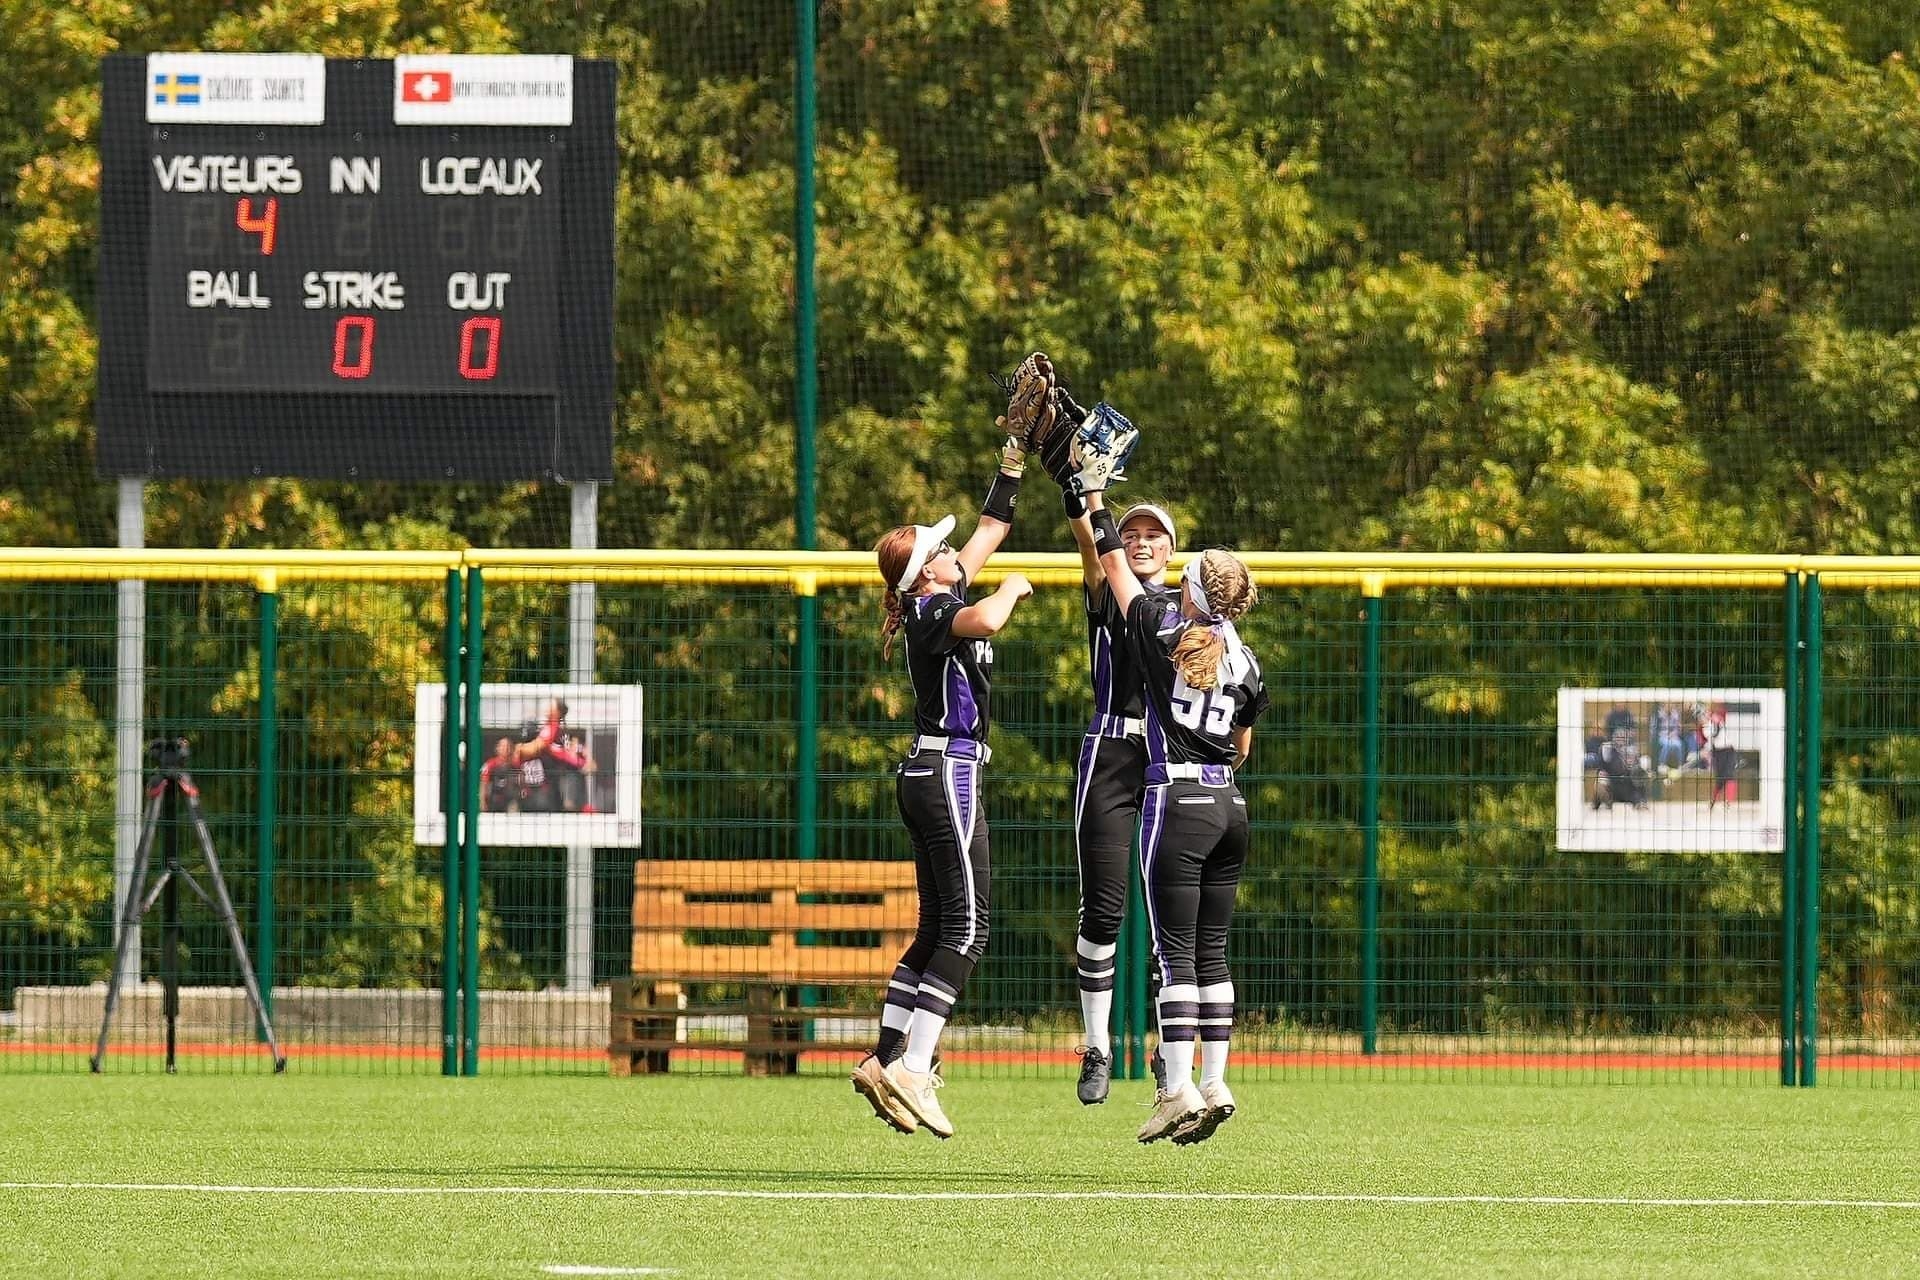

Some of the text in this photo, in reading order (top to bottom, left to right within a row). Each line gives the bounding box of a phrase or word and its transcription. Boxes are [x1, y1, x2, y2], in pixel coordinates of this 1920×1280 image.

[153, 155, 302, 193] VISITEURS
[330, 157, 380, 193] INN
[420, 157, 542, 195] LOCAUX
[236, 197, 279, 255] 4
[187, 271, 271, 308] BALL
[303, 271, 405, 309] STRIKE
[448, 272, 511, 310] OUT
[332, 316, 376, 379] 0
[459, 316, 502, 380] 0
[1171, 671, 1235, 736] 55
